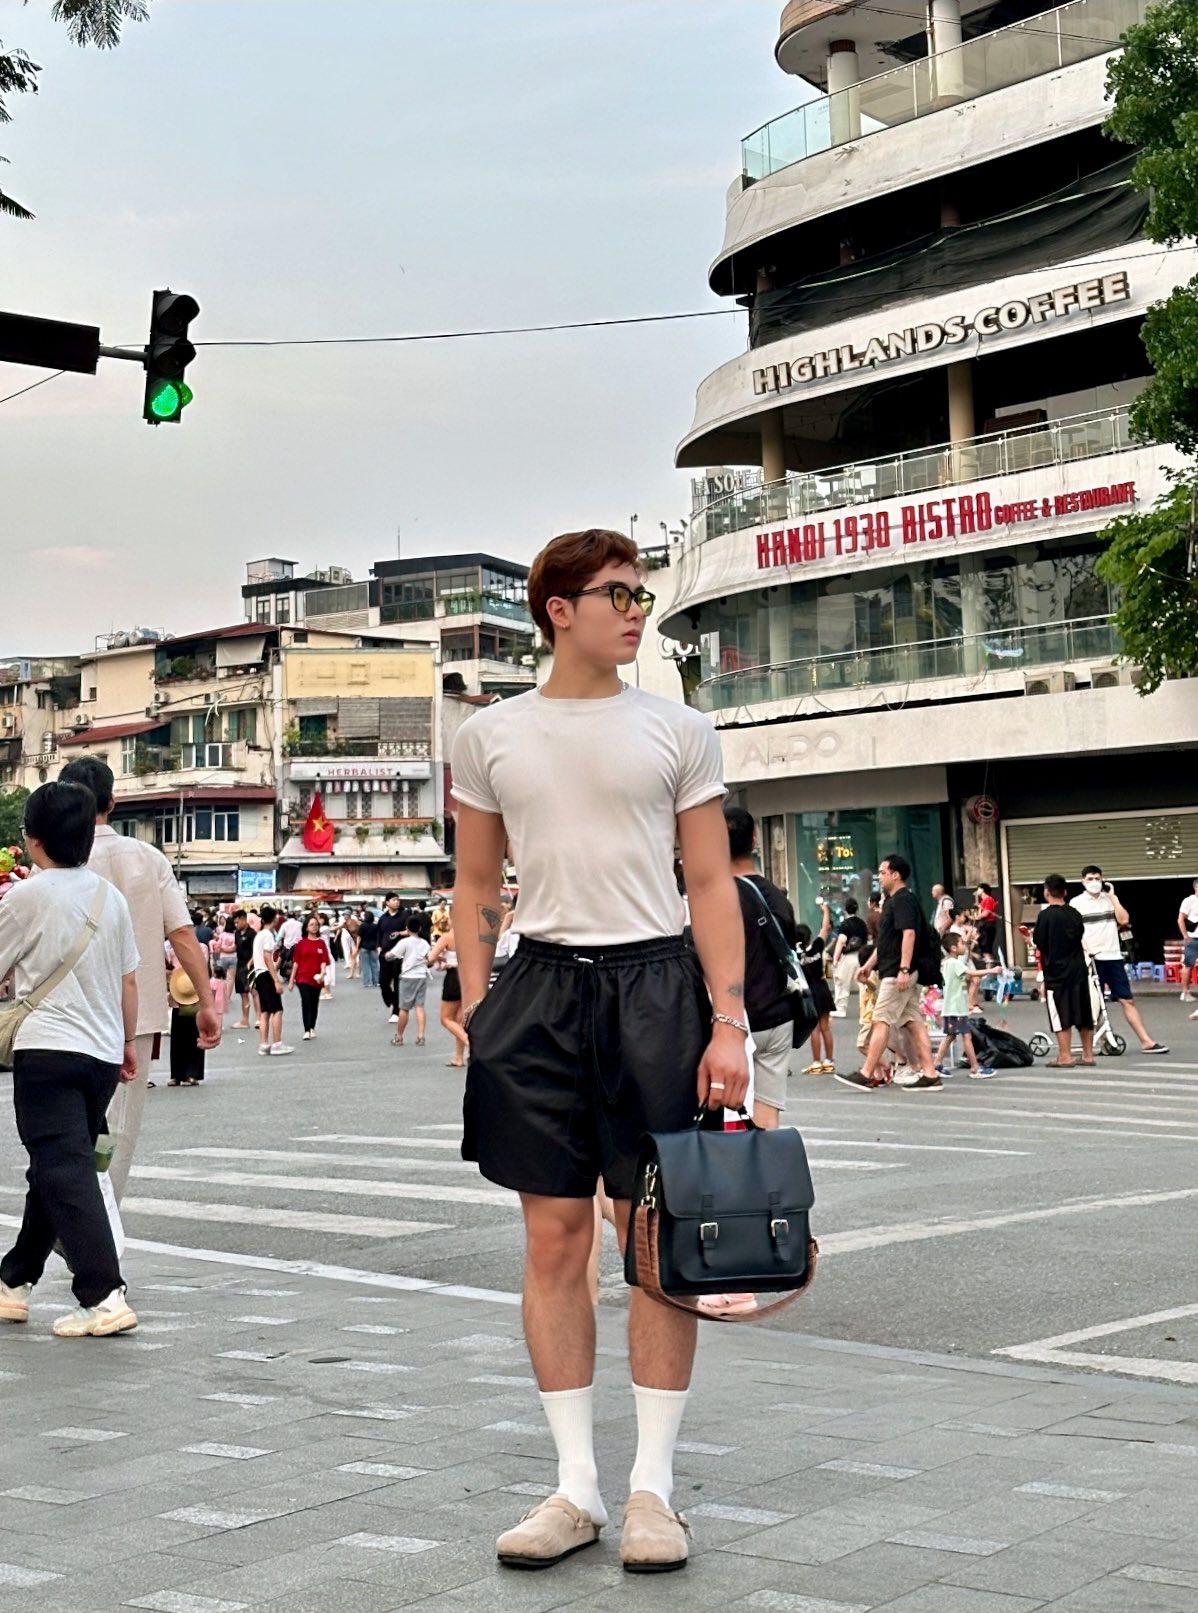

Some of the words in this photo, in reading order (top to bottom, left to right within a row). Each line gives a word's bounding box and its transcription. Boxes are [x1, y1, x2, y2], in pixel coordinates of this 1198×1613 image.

[753, 315, 967, 395] HIGHLANDS
[974, 271, 1131, 335] COFFEE
[756, 521, 825, 569] HANOI
[833, 511, 890, 556] 1930
[901, 491, 991, 544] BISTRO
[994, 499, 1038, 525] COFFEE
[1041, 497, 1052, 517] &
[1054, 481, 1136, 515] RESTAURANT
[327, 767, 393, 777] HERBALIST
